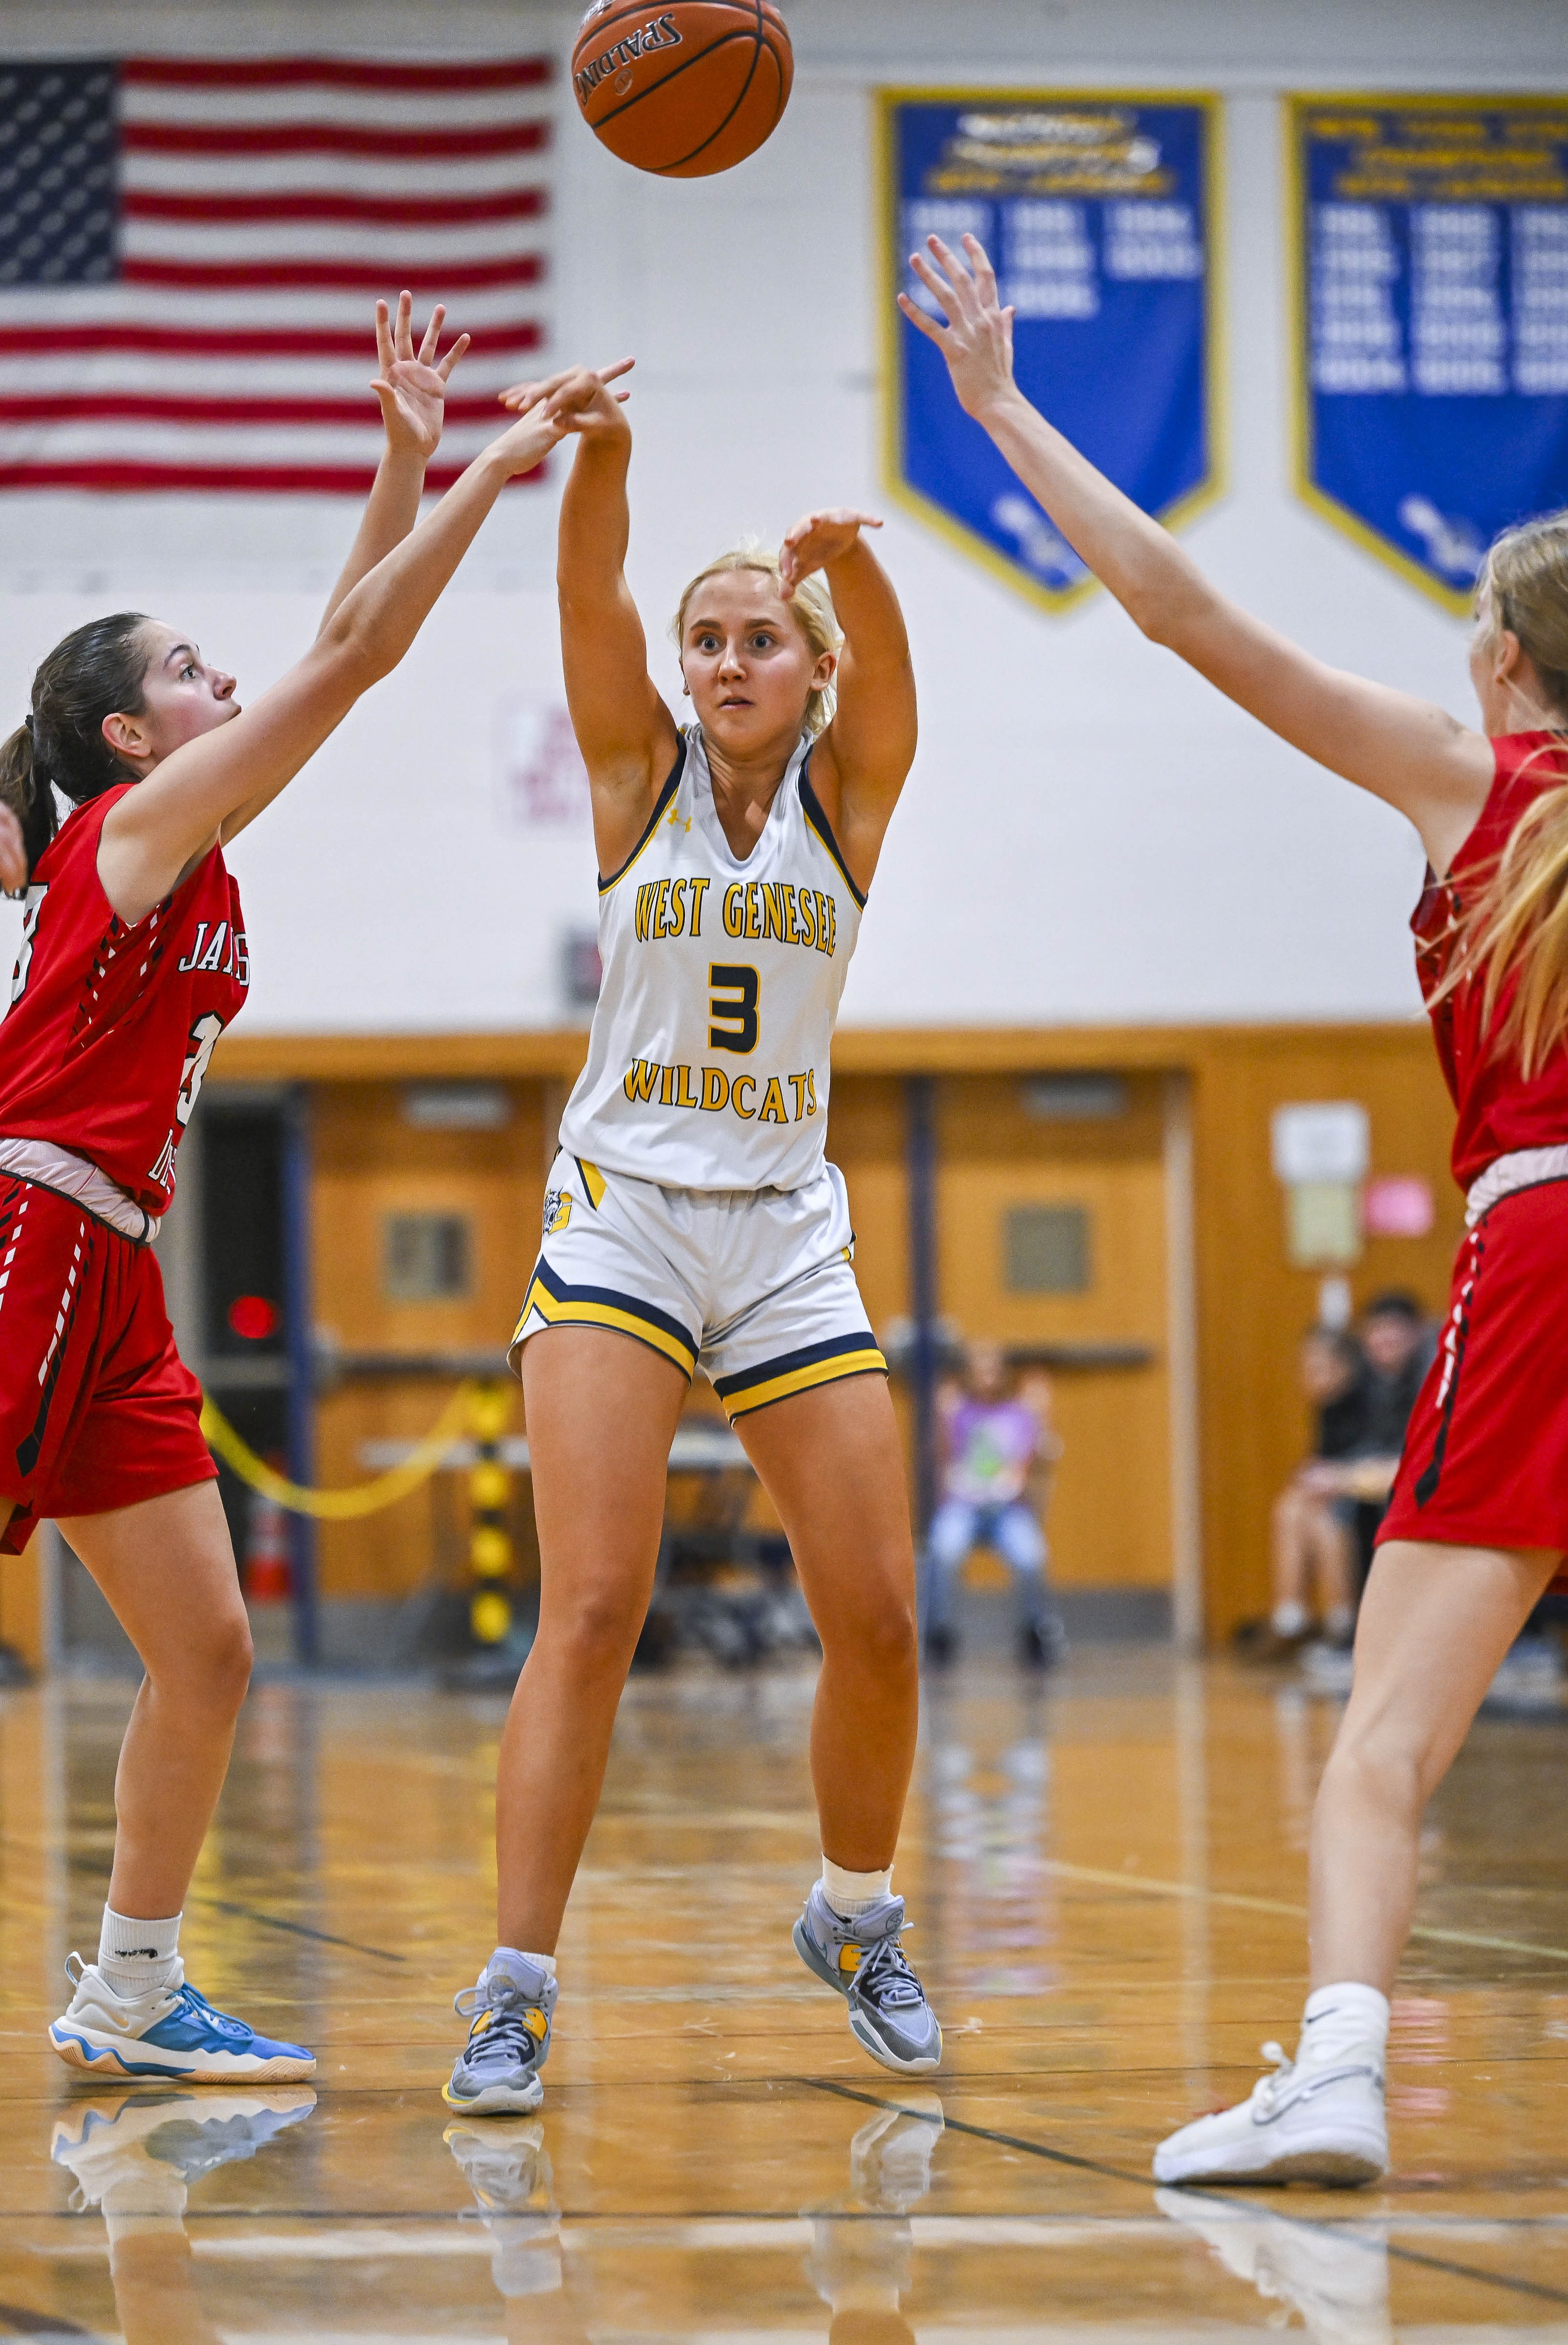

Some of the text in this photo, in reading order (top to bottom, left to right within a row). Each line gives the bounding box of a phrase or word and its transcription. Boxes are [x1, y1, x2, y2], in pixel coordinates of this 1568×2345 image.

[574, 12, 682, 106] SPALDING
[635, 878, 835, 958] WEST GENESEE
[708, 962, 761, 1056] 3
[623, 1058, 816, 1124] WILDCATS
